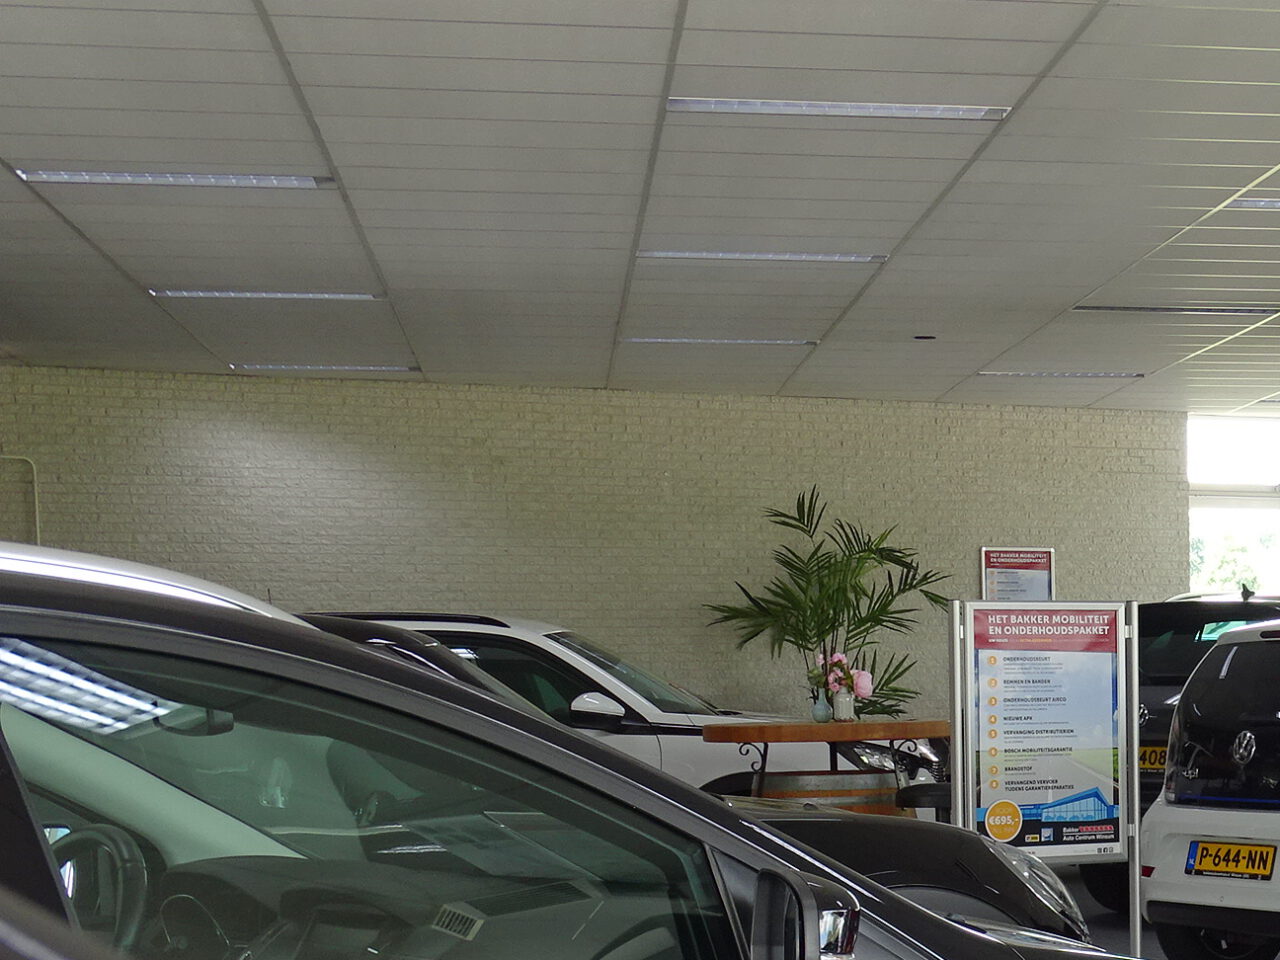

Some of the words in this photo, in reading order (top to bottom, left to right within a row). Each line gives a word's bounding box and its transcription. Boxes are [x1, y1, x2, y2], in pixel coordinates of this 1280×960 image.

[988, 615, 1008, 624] HET
[1010, 615, 1050, 624] BAKKER
[1052, 615, 1110, 624] MOBILITEIT
[988, 626, 1002, 635] EN
[1004, 626, 1110, 635] ONDERHOUDSPAKKET
[989, 816, 1019, 826] €695,-
[1199, 846, 1270, 871] P-644-NN
